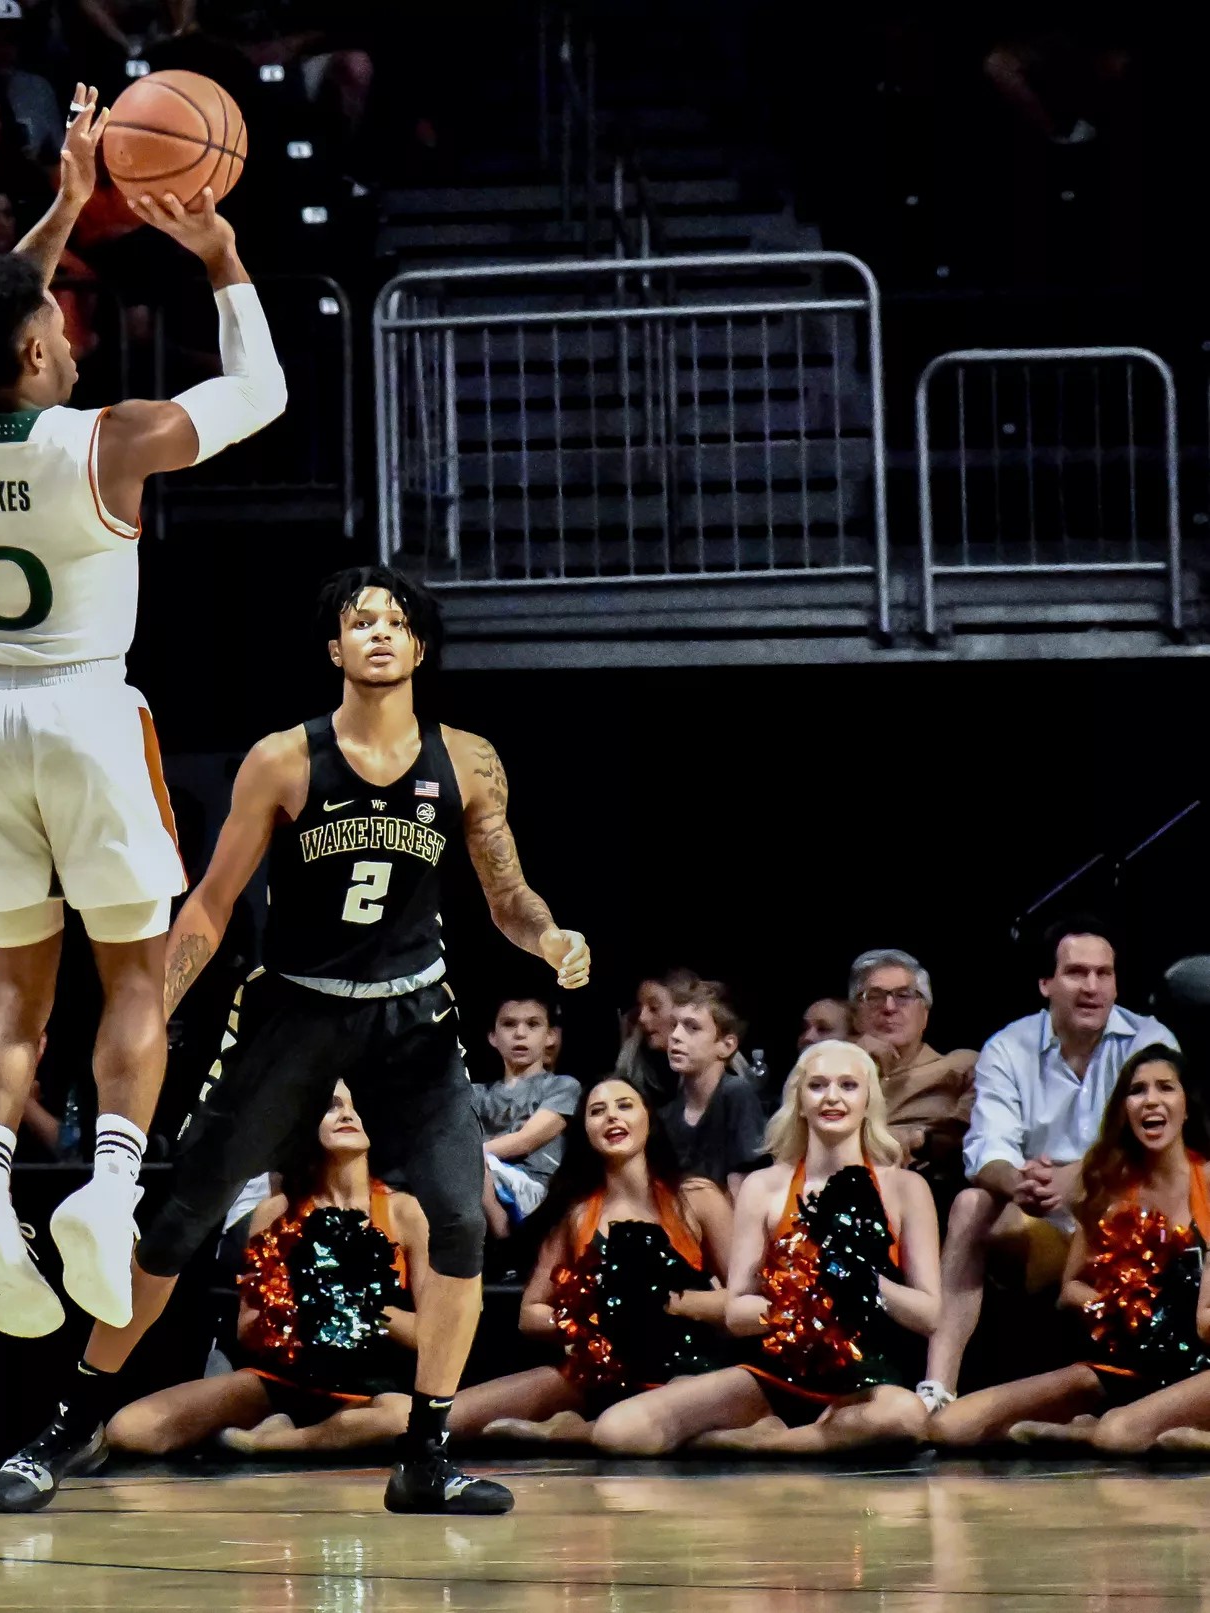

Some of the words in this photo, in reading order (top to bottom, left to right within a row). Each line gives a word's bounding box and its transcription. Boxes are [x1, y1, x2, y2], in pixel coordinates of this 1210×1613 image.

[300, 817, 369, 863] WAKE
[370, 816, 447, 867] FOREST
[341, 860, 393, 925] 2
